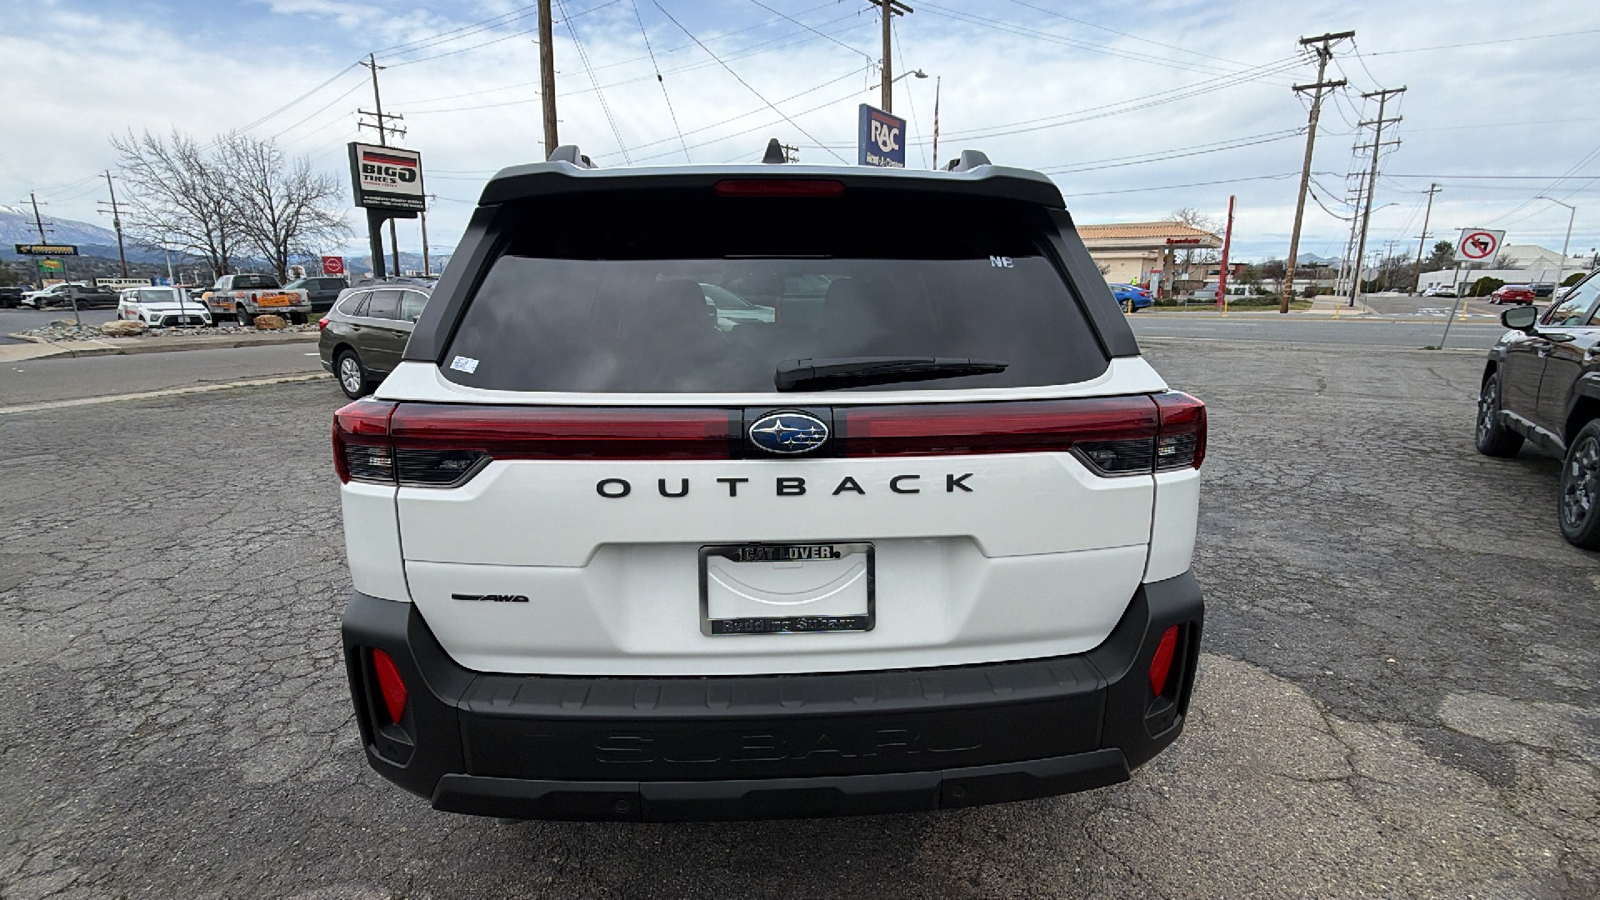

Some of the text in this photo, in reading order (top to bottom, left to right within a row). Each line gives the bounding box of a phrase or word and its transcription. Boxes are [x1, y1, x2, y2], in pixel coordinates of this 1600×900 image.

[871, 119, 899, 152] RAC
[362, 163, 397, 177] BIG
[596, 473, 974, 498] OUTBACK
[745, 546, 832, 560] CAT LOVER
[480, 594, 530, 603] AWD
